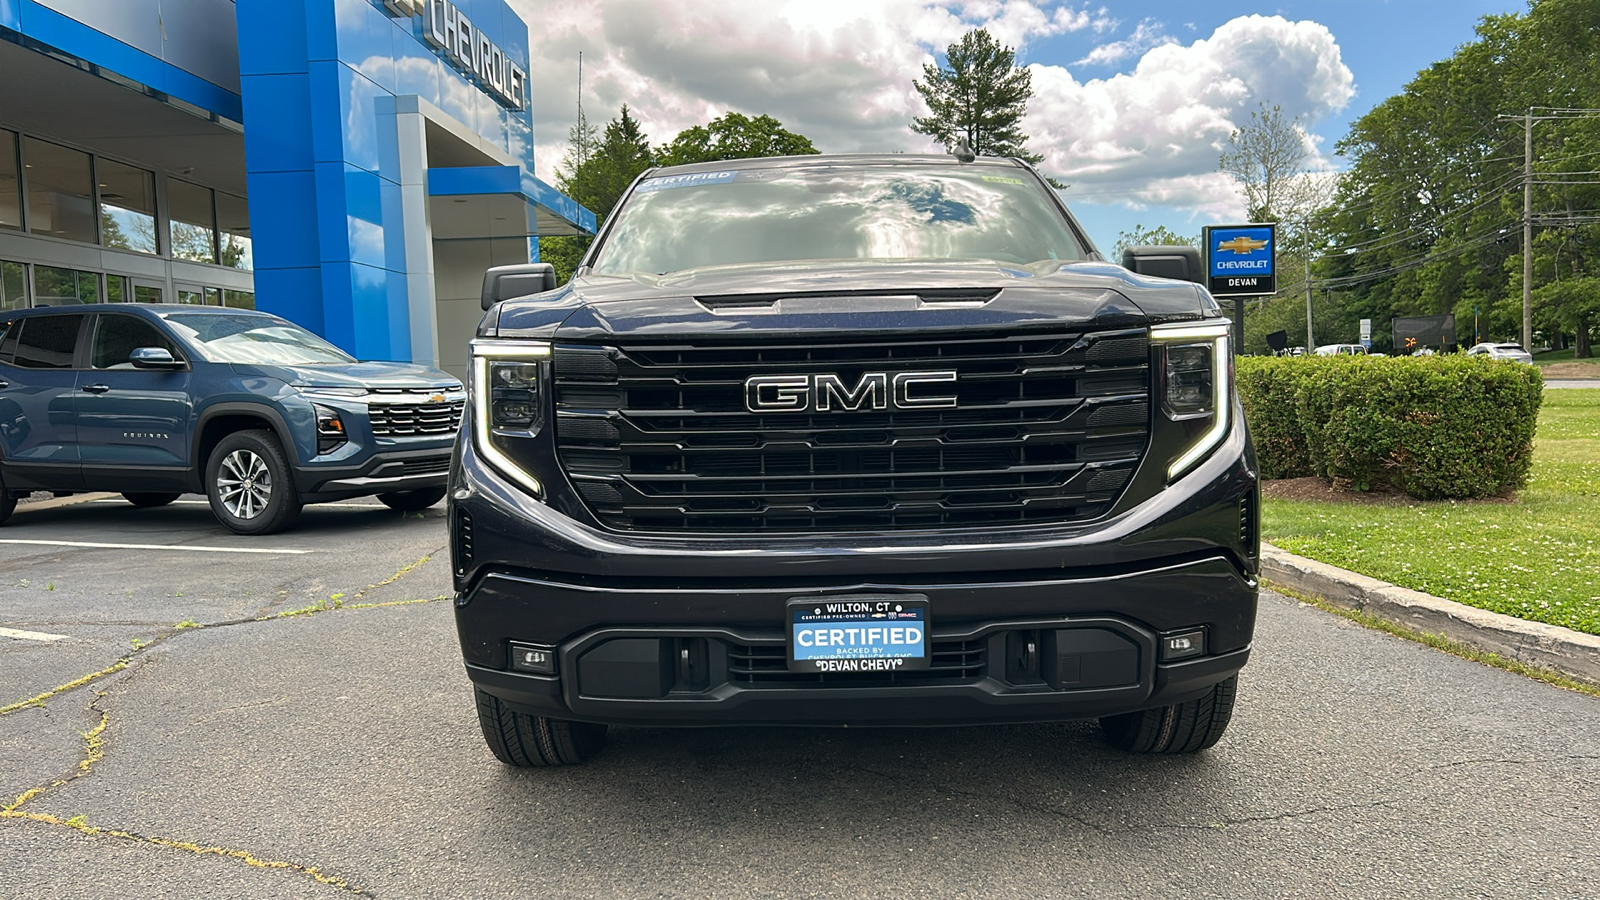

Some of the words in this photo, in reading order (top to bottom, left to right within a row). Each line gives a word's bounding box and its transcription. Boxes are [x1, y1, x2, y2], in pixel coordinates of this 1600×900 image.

[424, 0, 526, 111] CHEVROLET
[642, 171, 731, 187] CERTIFIED
[1216, 260, 1268, 269] CHEVROLET
[1228, 278, 1257, 286] DEVAN
[745, 370, 957, 412] GMC
[826, 603, 872, 613] WILTON,
[876, 602, 890, 612] CT
[797, 627, 922, 647] CERTIFIED
[821, 660, 858, 672] DEVAN
[860, 659, 897, 671] CHEVY
